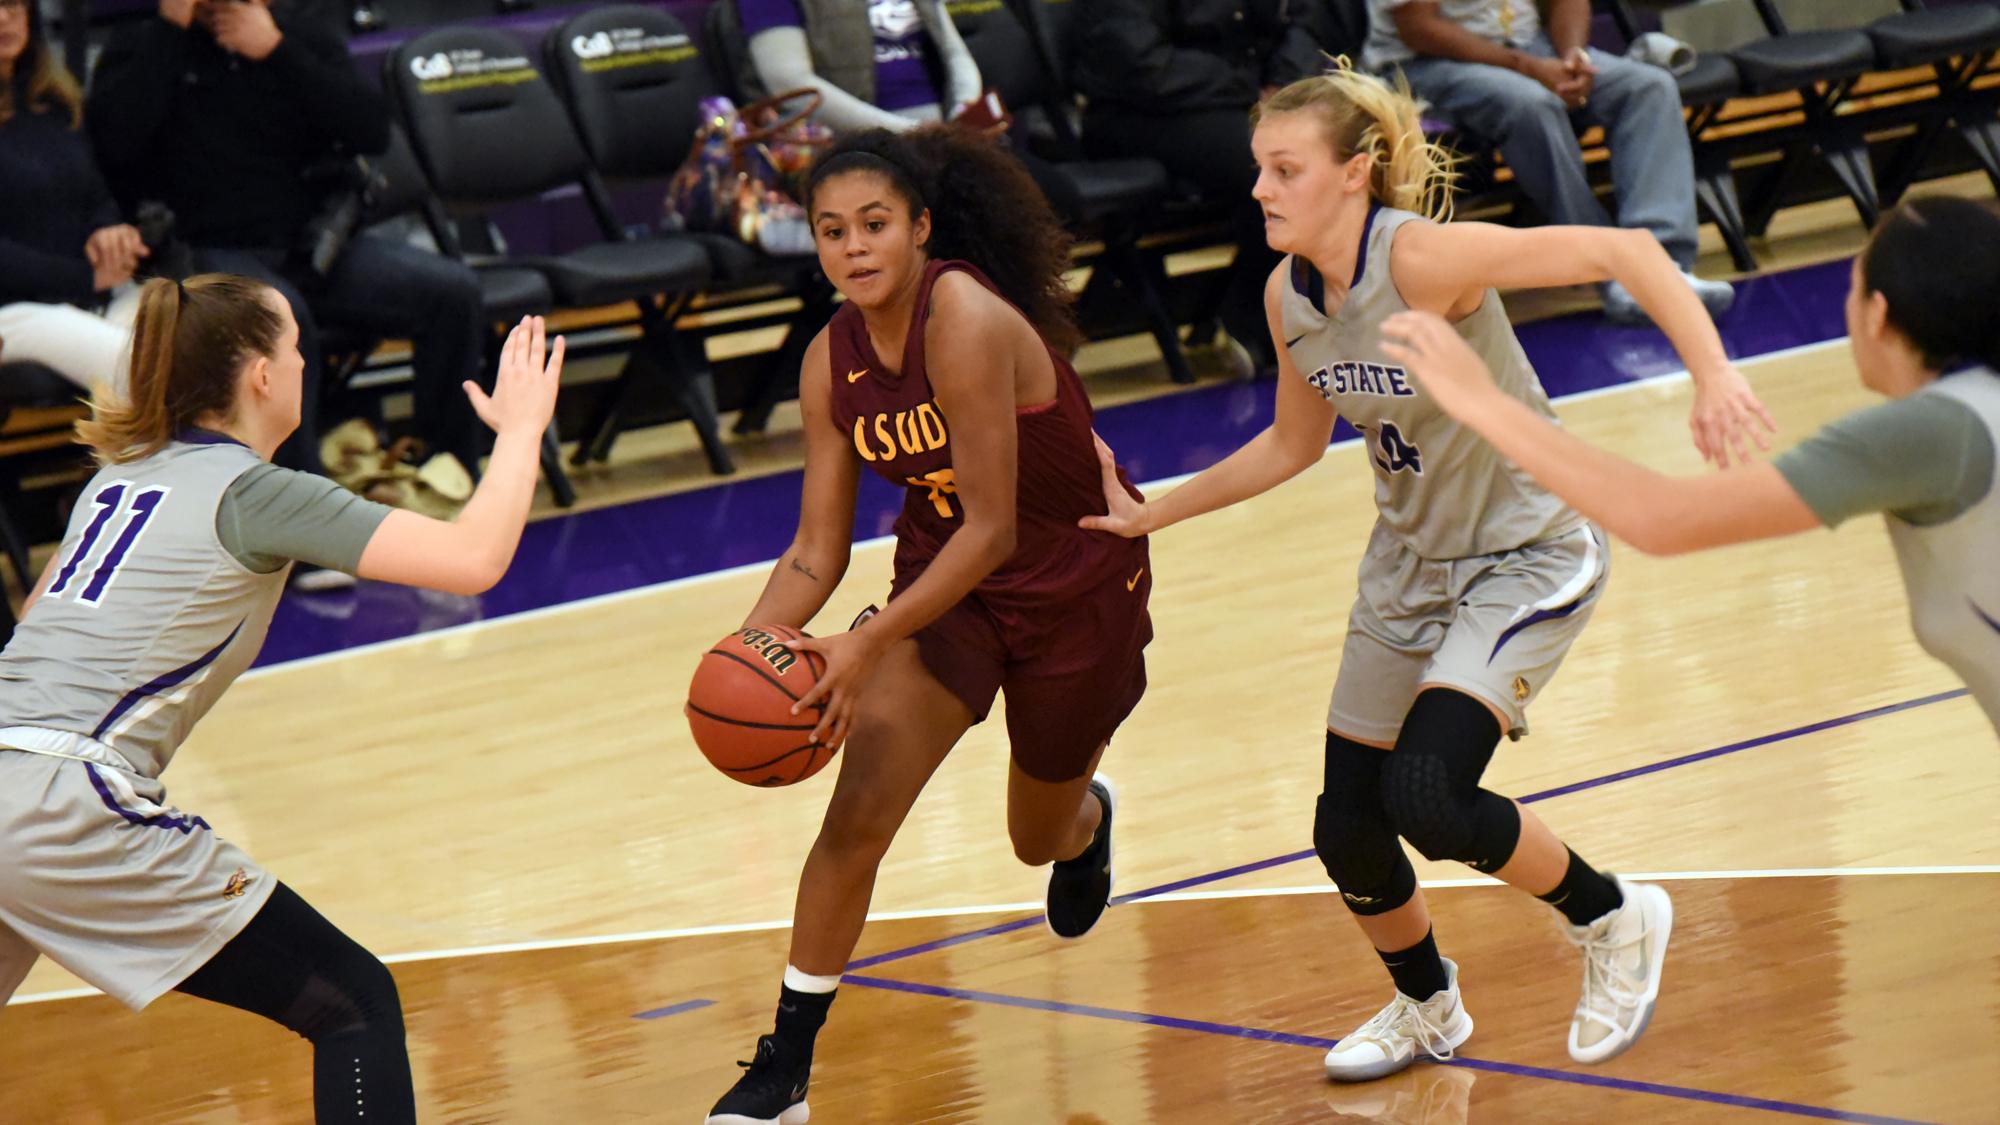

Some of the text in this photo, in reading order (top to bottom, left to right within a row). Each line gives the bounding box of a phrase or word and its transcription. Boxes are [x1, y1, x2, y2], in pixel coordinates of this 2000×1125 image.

[1332, 361, 1417, 397] STATE
[853, 397, 948, 462] CSUD
[42, 478, 172, 609] 11
